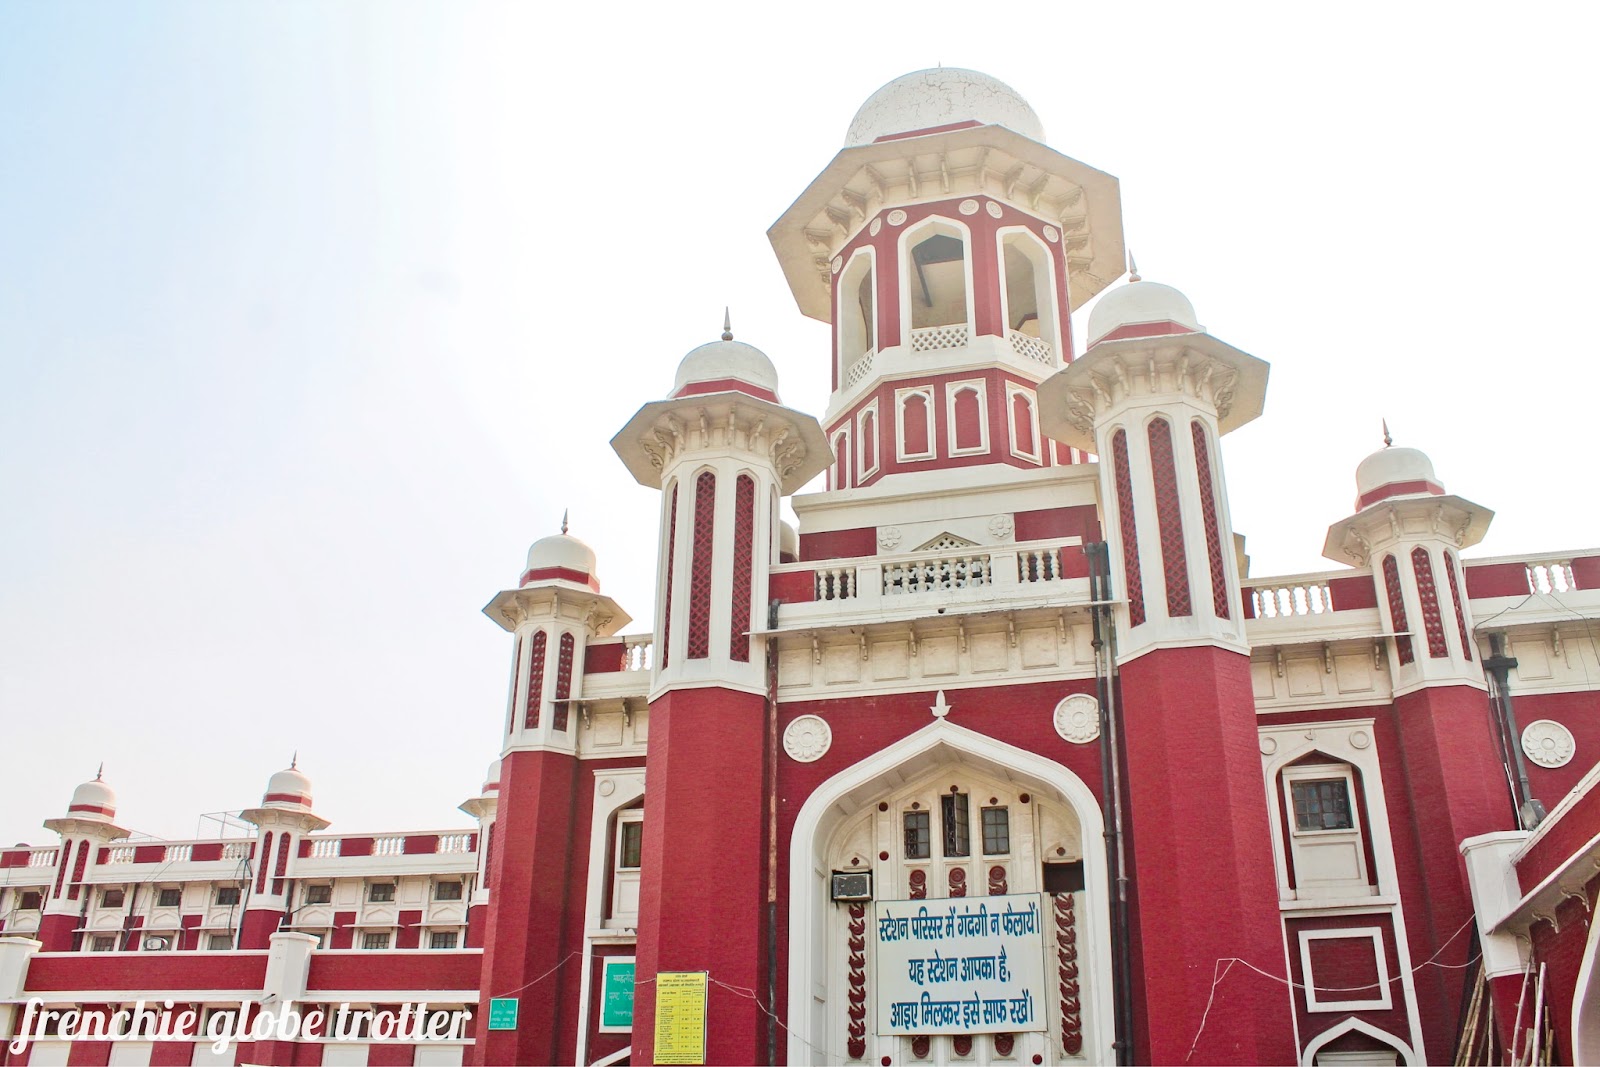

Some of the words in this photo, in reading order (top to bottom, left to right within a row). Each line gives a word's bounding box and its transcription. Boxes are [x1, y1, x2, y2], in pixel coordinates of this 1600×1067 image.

[879, 909, 909, 942] स्टेशन
[911, 906, 944, 940] परिसर
[945, 906, 956, 938] में
[957, 903, 988, 937] गंदगी
[990, 913, 1000, 936] न
[908, 959, 925, 985] यह
[927, 949, 958, 983] स्टेशन
[960, 955, 996, 982] आपका
[890, 1002, 918, 1030] आइए
[920, 991, 960, 1027] मिलकर
[963, 990, 980, 1029] इसे
[983, 999, 1007, 1024] साफ
